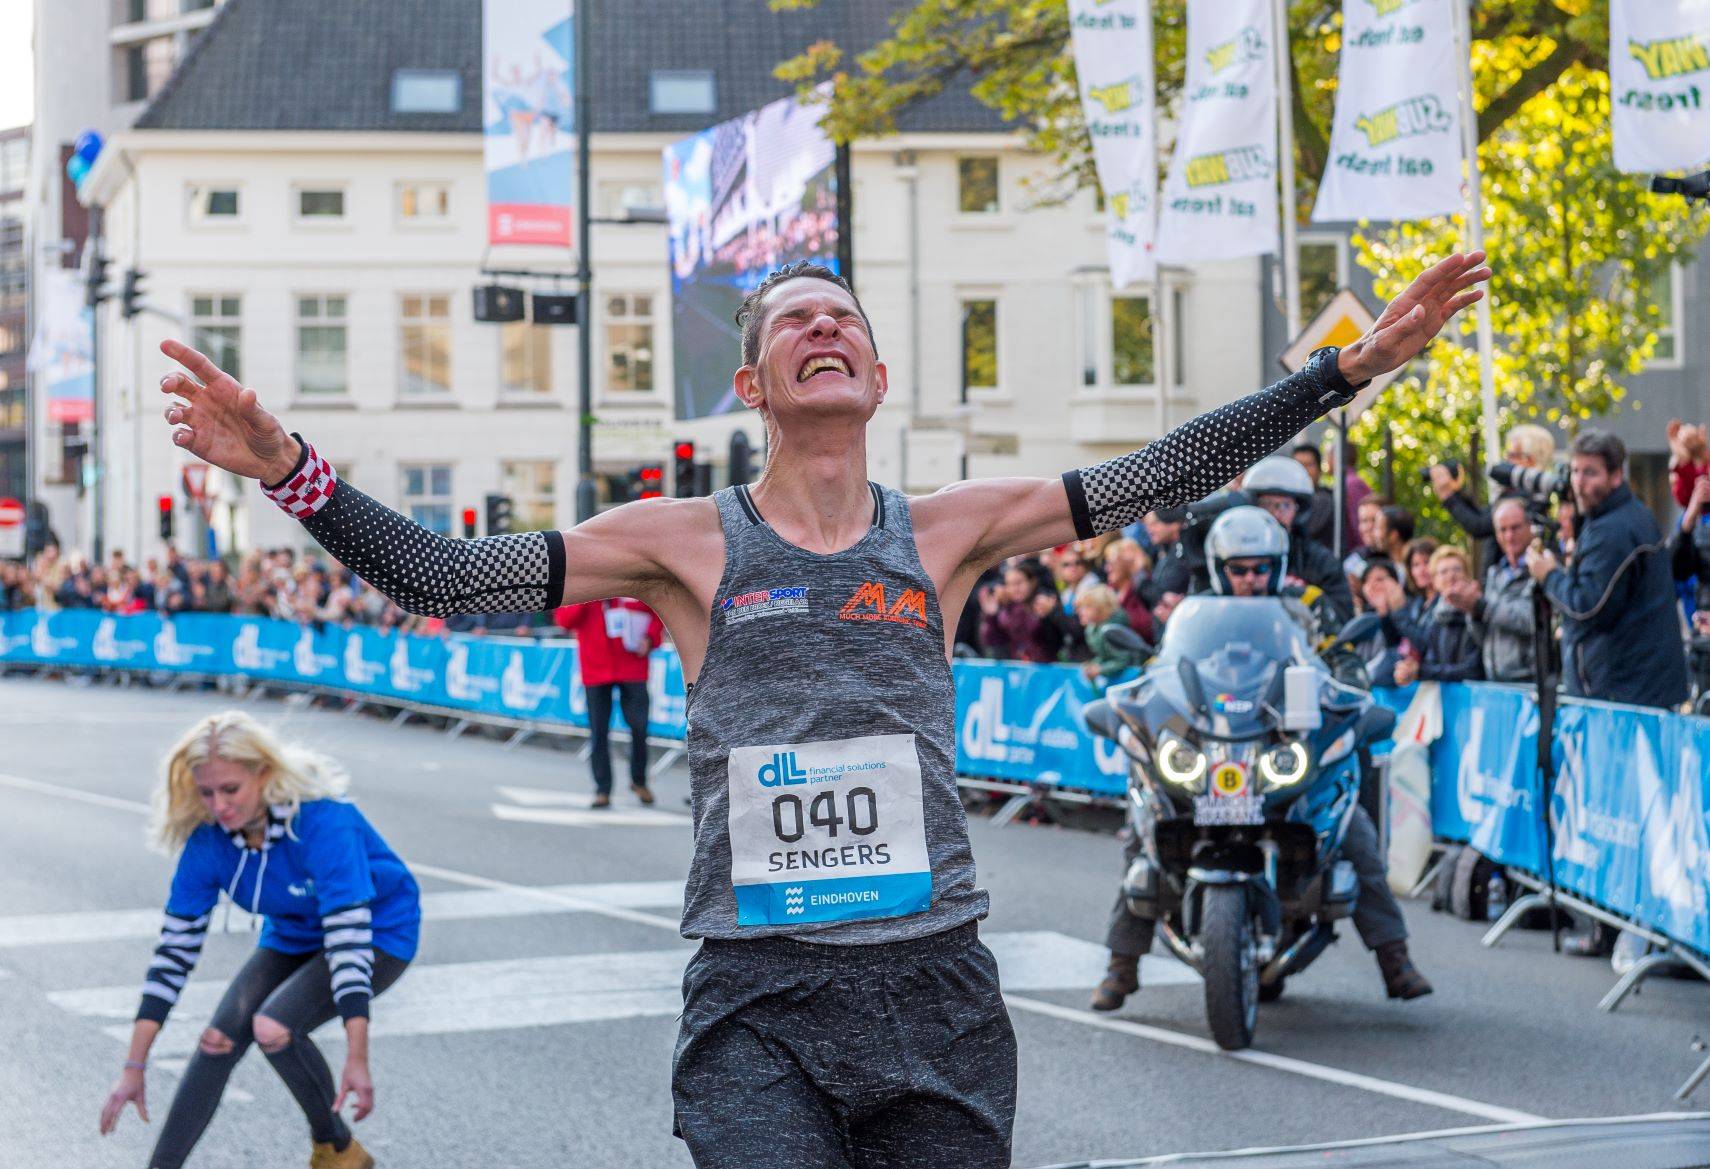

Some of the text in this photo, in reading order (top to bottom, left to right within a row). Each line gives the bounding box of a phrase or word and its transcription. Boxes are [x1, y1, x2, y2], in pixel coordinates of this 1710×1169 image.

[733, 586, 807, 607] INTERSPORT
[809, 763, 846, 775] financial
[847, 761, 887, 771] solutions
[810, 774, 843, 785] partner
[1225, 770, 1236, 788] B
[772, 787, 879, 843] 040
[768, 843, 892, 872] SENGERS
[811, 890, 879, 906] EINDHOVEN
